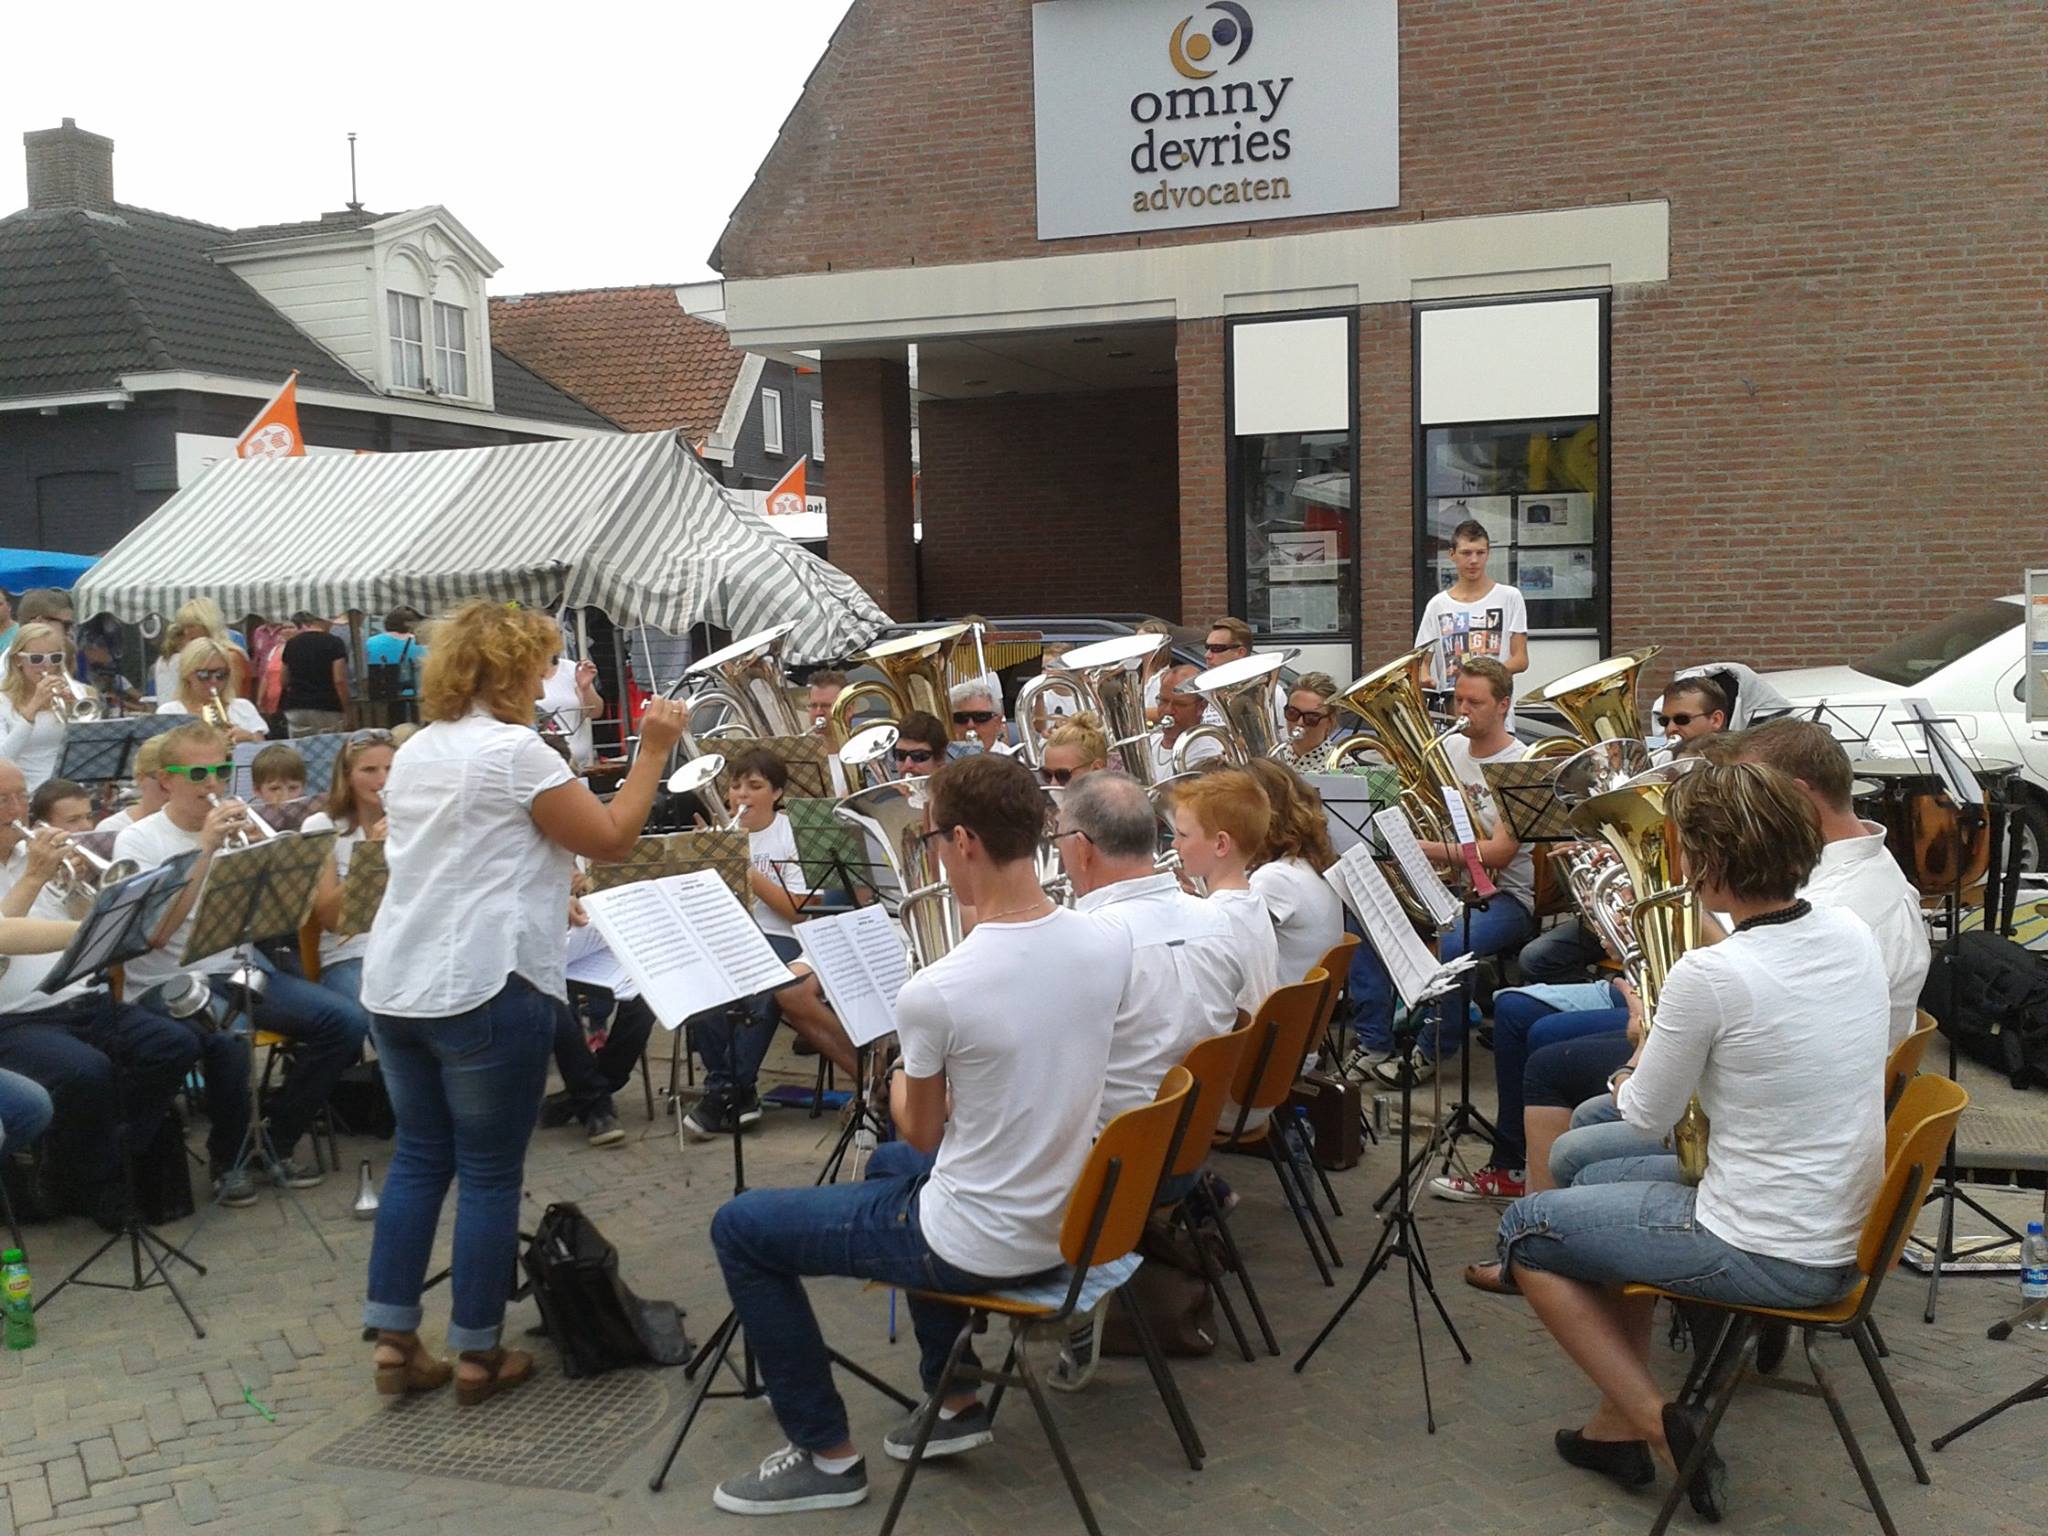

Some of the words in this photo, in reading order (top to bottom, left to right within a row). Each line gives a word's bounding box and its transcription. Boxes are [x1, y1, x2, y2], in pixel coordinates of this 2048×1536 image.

[1130, 76, 1294, 124] omny
[1130, 121, 1291, 174] devries
[1132, 175, 1291, 213] advocaten
